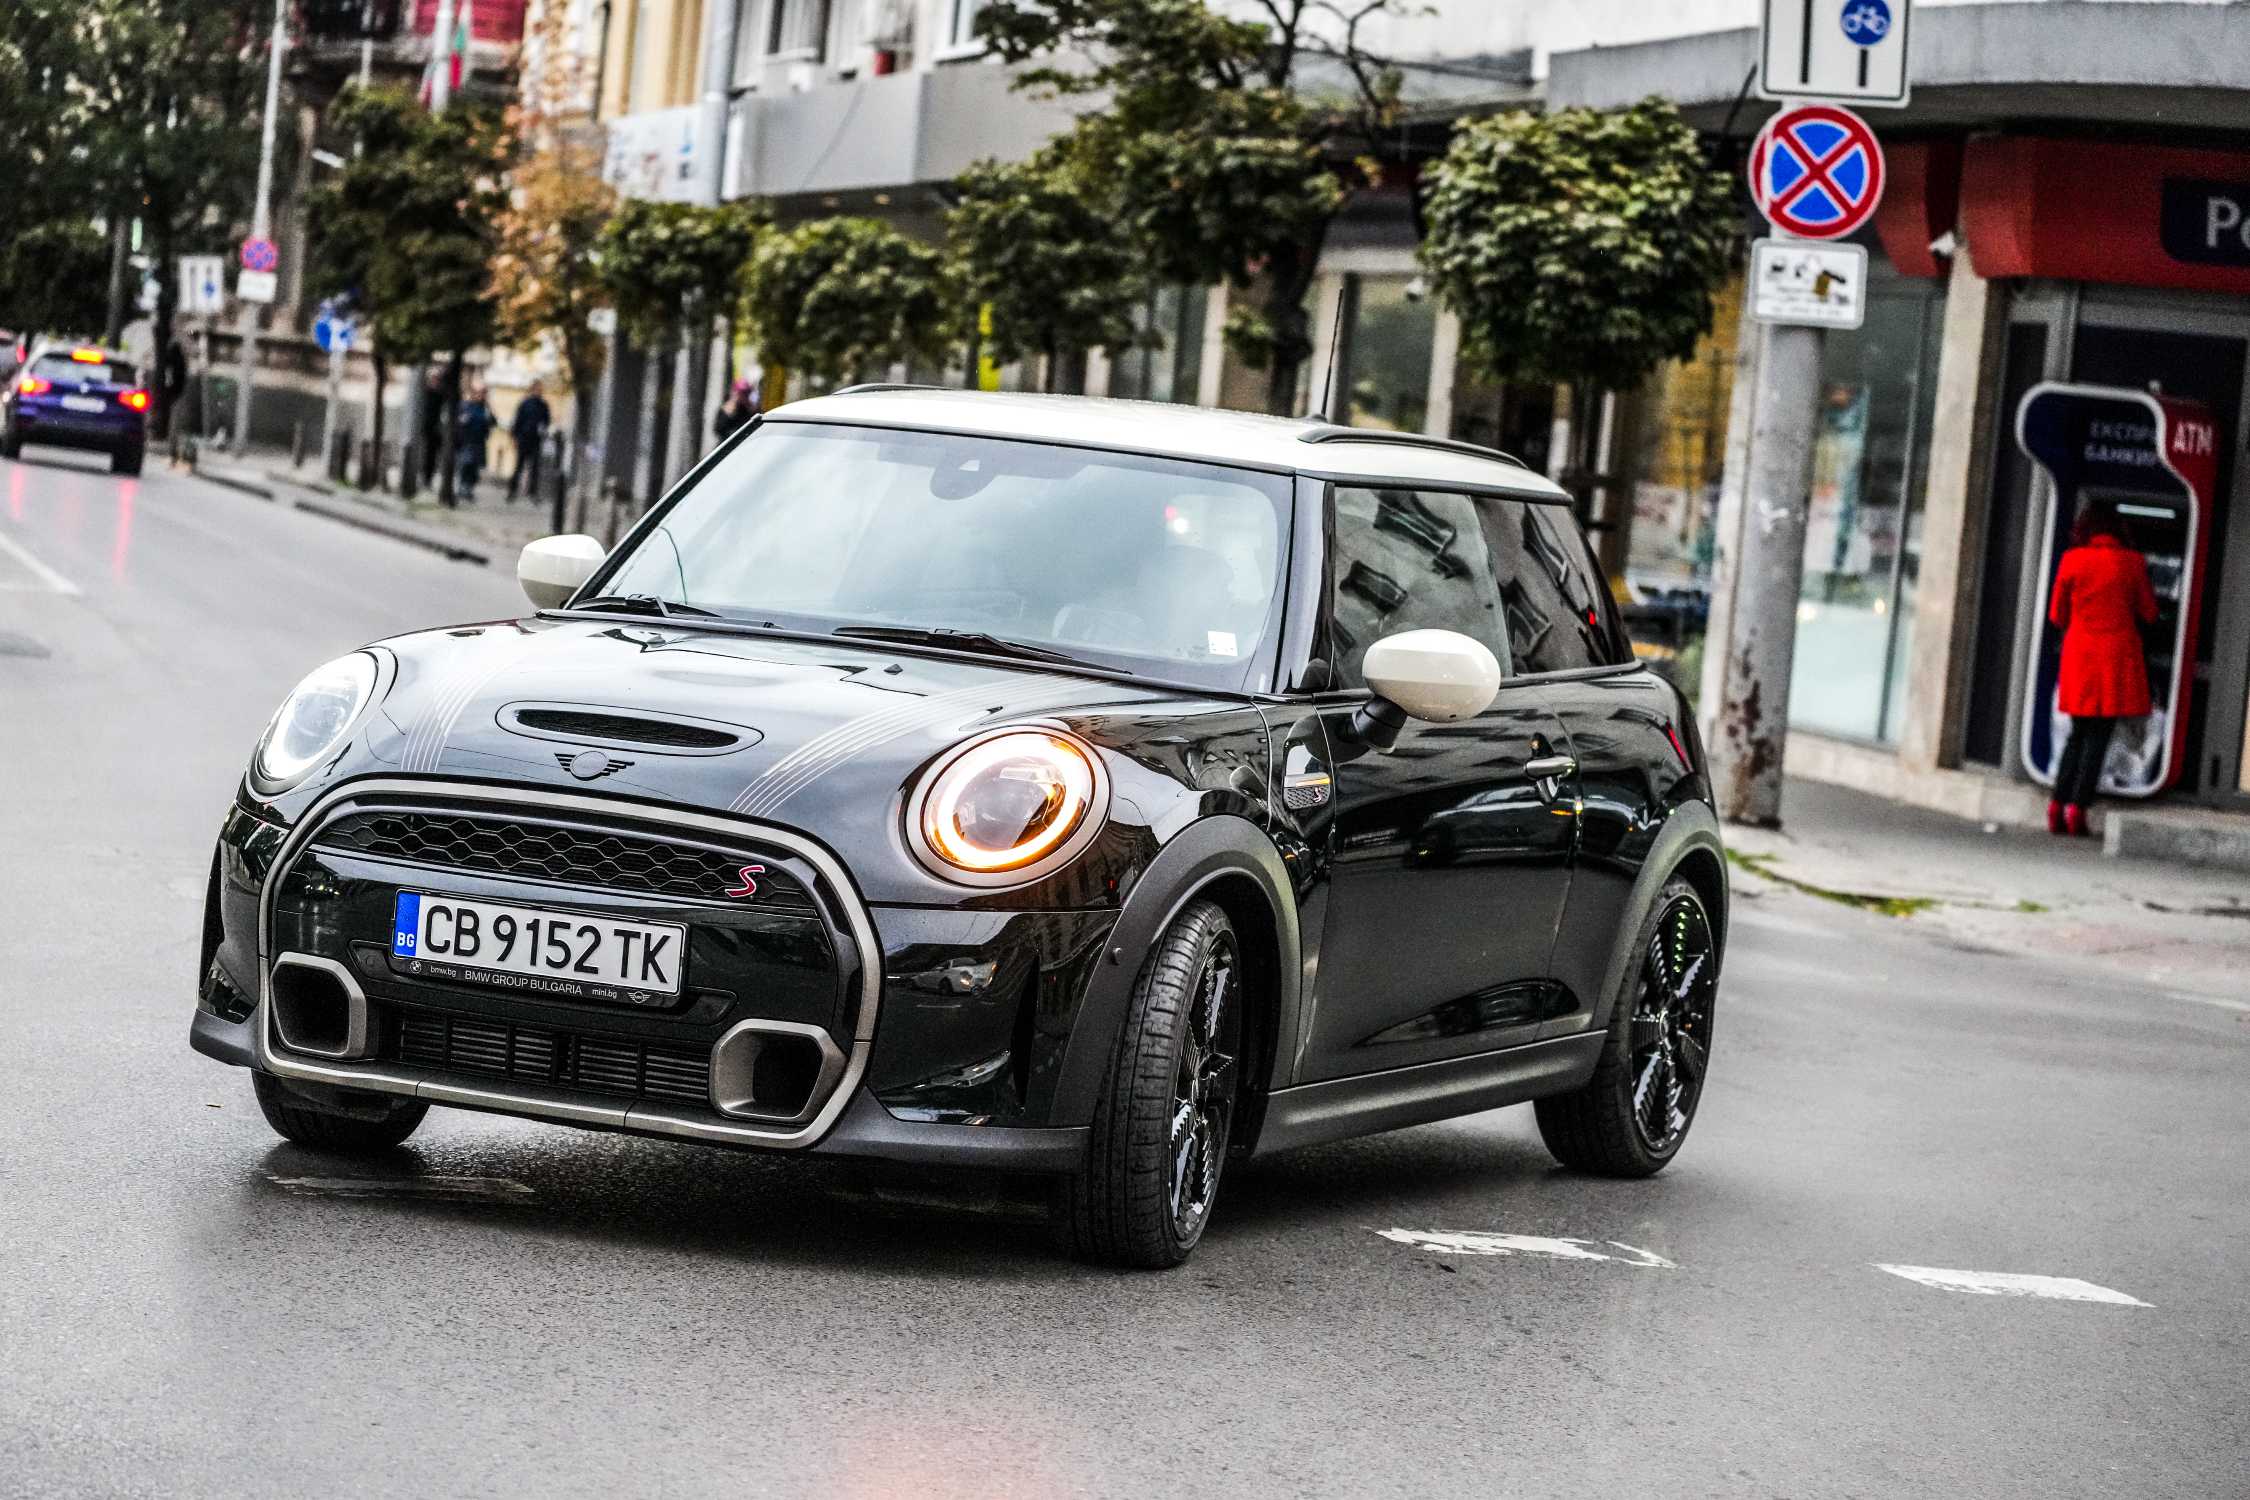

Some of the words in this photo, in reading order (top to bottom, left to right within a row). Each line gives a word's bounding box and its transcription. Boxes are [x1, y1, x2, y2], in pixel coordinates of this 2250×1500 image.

[2173, 421, 2213, 455] ATM
[724, 864, 766, 898] S
[396, 931, 416, 948] BG
[424, 904, 481, 957] CB
[492, 913, 602, 976] 9152
[613, 928, 672, 984] TK
[429, 965, 457, 978] bmw.bg
[464, 969, 491, 983] BMW
[491, 973, 529, 988] GROUP
[529, 979, 583, 996] BULGARIA
[591, 988, 618, 1000] mini.bg
